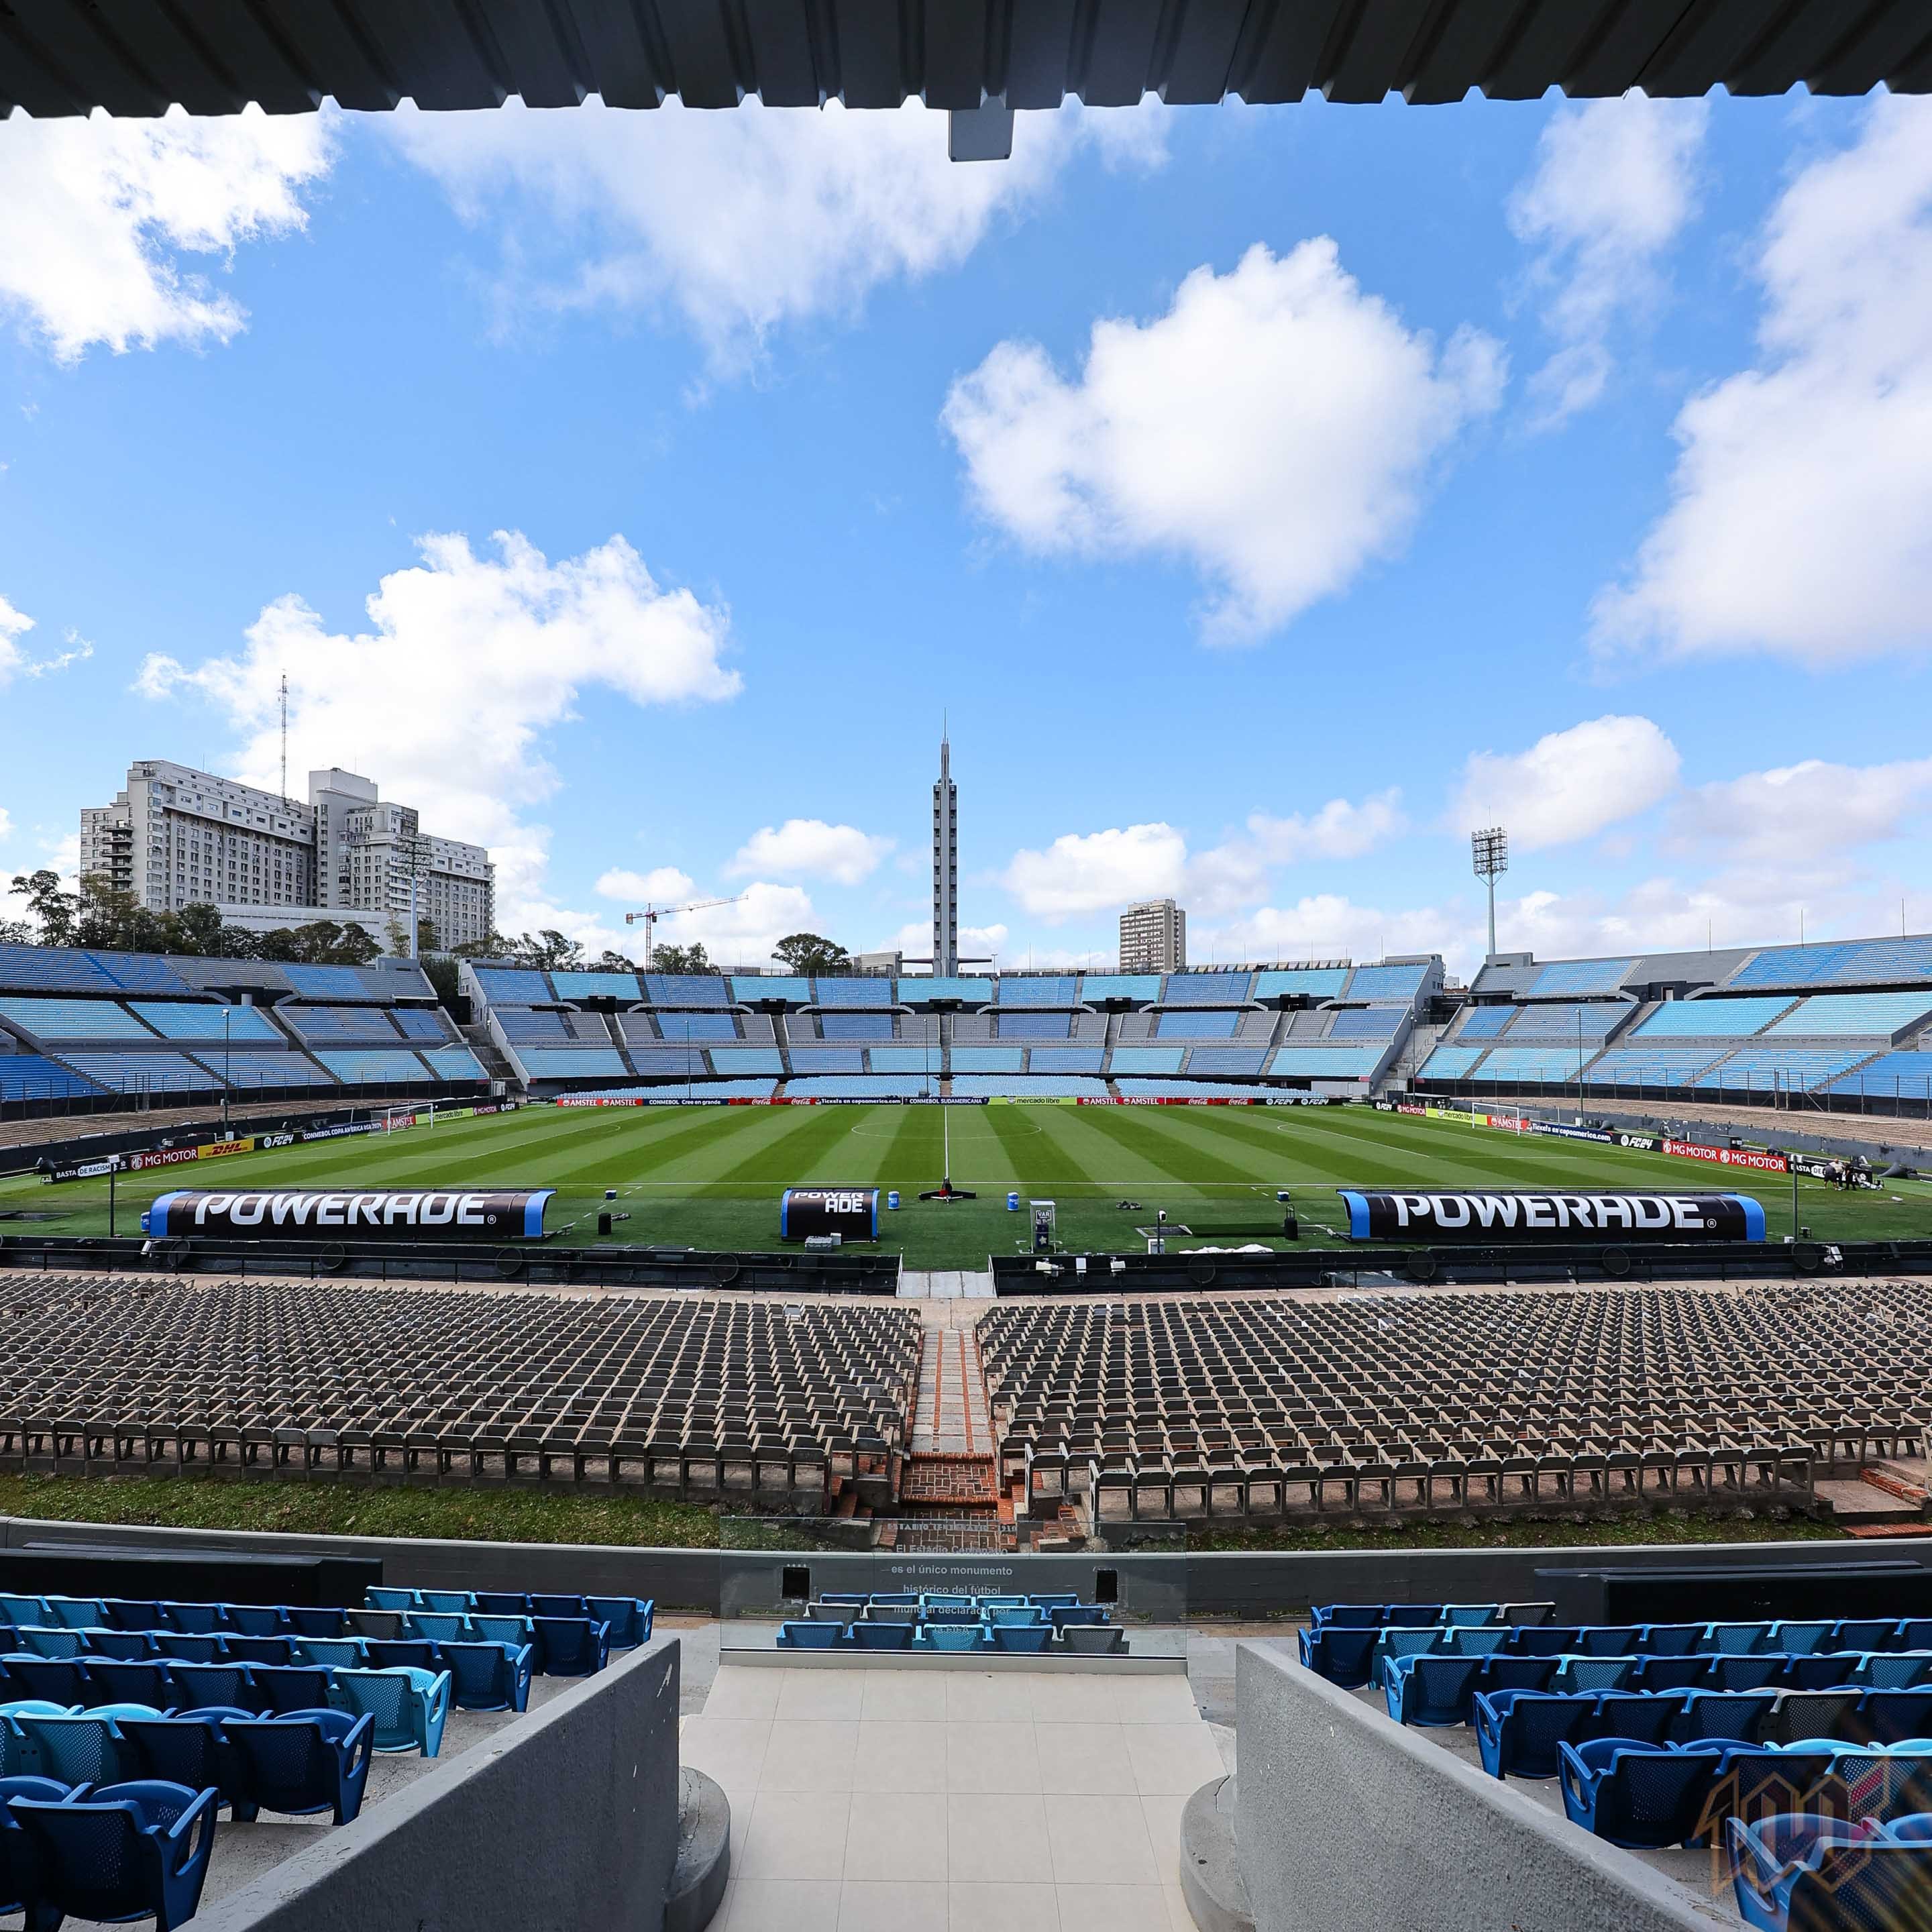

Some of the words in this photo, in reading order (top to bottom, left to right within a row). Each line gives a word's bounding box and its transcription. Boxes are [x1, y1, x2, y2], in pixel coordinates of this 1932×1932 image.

[435, 1111, 453, 1120] mercado
[453, 1110, 463, 1118] libre
[1410, 1107, 1426, 1115] MOTOR
[1444, 1111, 1464, 1120] mercado
[392, 1116, 413, 1129] AMSTEL
[1497, 1117, 1523, 1130] AMSTEL
[303, 1130, 331, 1139] CONMEBOL
[331, 1127, 343, 1136] COPA
[212, 1142, 241, 1155] DHL
[1673, 1145, 1685, 1155] MG
[1686, 1147, 1717, 1160] MOTOR
[145, 1155, 161, 1167] MG
[163, 1149, 197, 1164] MOTOR
[1731, 1153, 1746, 1165] MG
[1748, 1156, 1786, 1171] MOTOR
[56, 1169, 77, 1179] BASTA
[89, 1165, 111, 1173] RACISM
[195, 1194, 494, 1225] POWERADE
[1389, 1194, 1705, 1228] POWERADE
[896, 1544, 906, 1553] El
[891, 1566, 903, 1574] es
[906, 1564, 916, 1574] el
[918, 1564, 948, 1574] único
[951, 1566, 1013, 1576] monumento
[903, 1584, 949, 1594] histórico
[952, 1585, 967, 1595] del
[971, 1585, 1001, 1595] fútbol
[993, 1608, 1011, 1617] por
